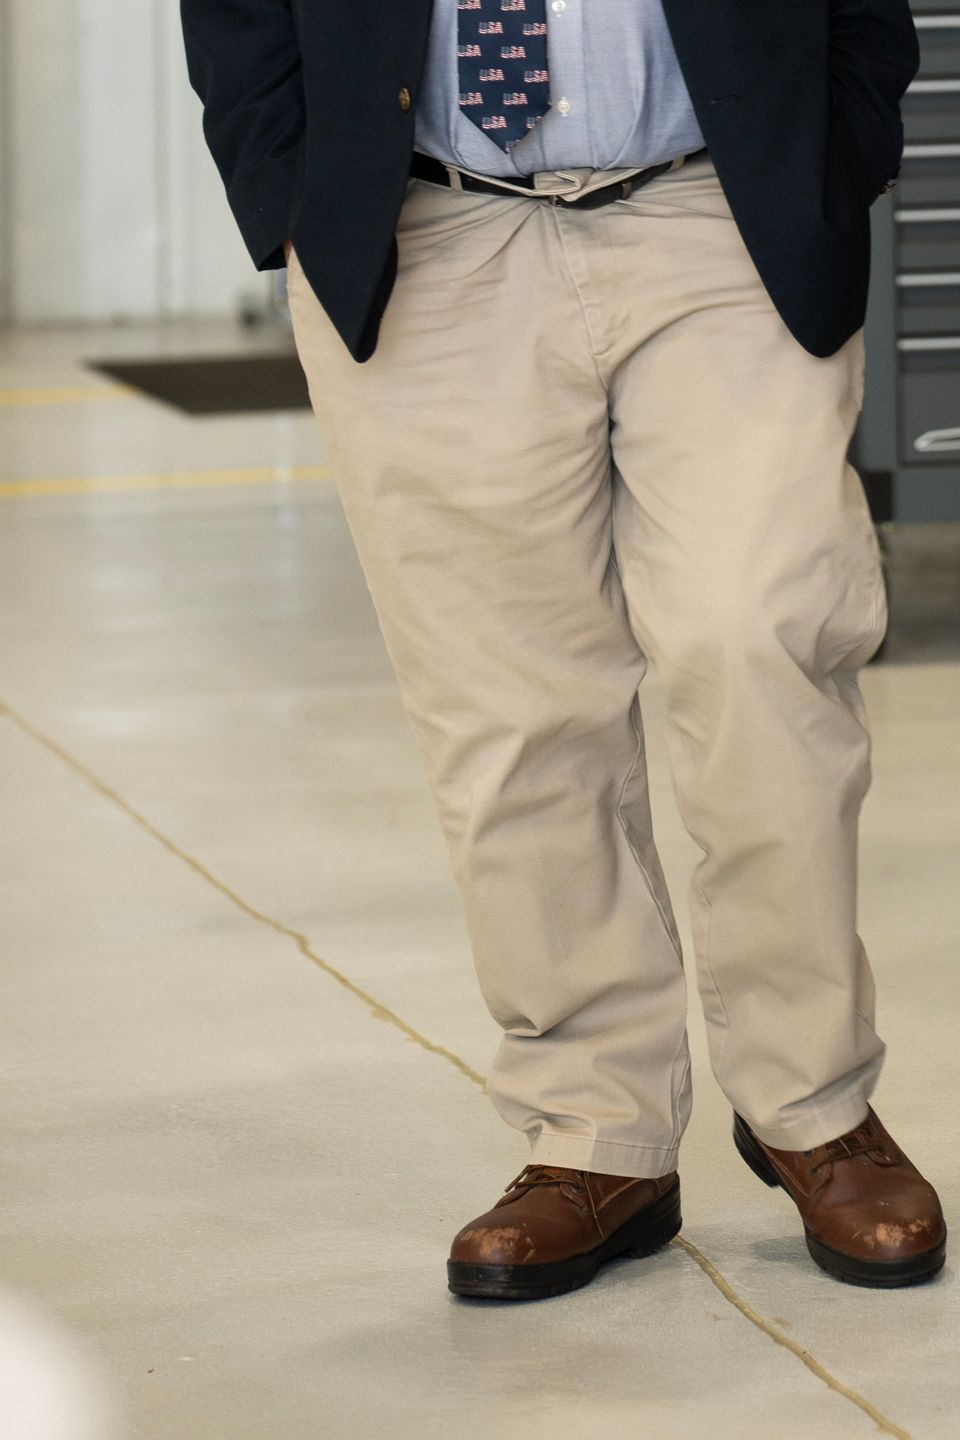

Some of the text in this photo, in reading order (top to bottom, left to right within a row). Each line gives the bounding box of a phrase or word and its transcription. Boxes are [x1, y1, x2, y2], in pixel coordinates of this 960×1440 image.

[478, 21, 503, 34] USA
[523, 23, 547, 36] USA
[457, 44, 481, 57] USA
[501, 46, 526, 59] USA
[480, 68, 504, 81] USA
[524, 70, 549, 83] USA
[459, 92, 483, 105] USA
[503, 92, 528, 105] USA
[482, 116, 507, 129] USA
